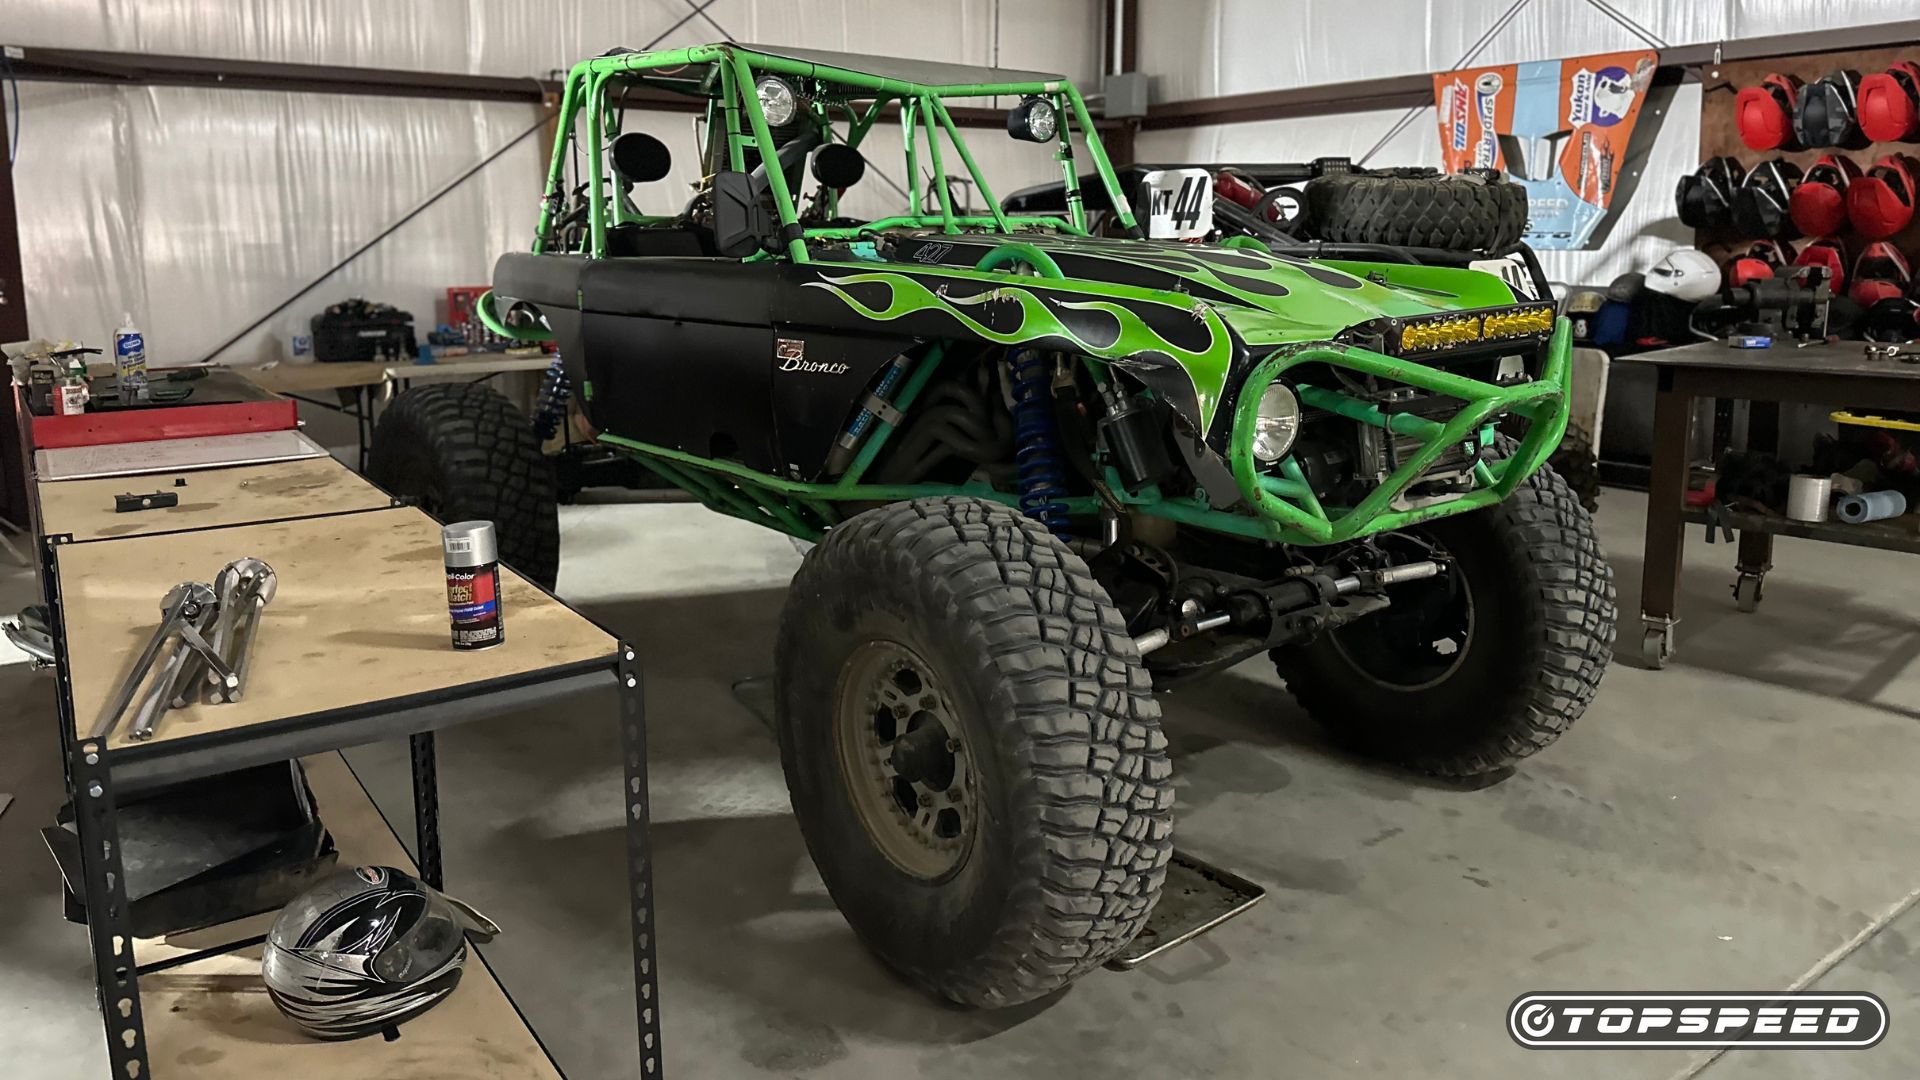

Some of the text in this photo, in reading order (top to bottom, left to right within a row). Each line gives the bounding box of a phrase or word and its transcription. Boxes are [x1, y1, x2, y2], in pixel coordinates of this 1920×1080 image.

[1454, 83, 1468, 149] AMSOIL
[1571, 74, 1586, 122] Yukon
[1483, 97, 1494, 169] SPIDERTRA
[1152, 176, 1208, 230] KT 44
[1528, 198, 1569, 209] PEED
[913, 242, 954, 264] 427
[779, 349, 851, 374] Bronco
